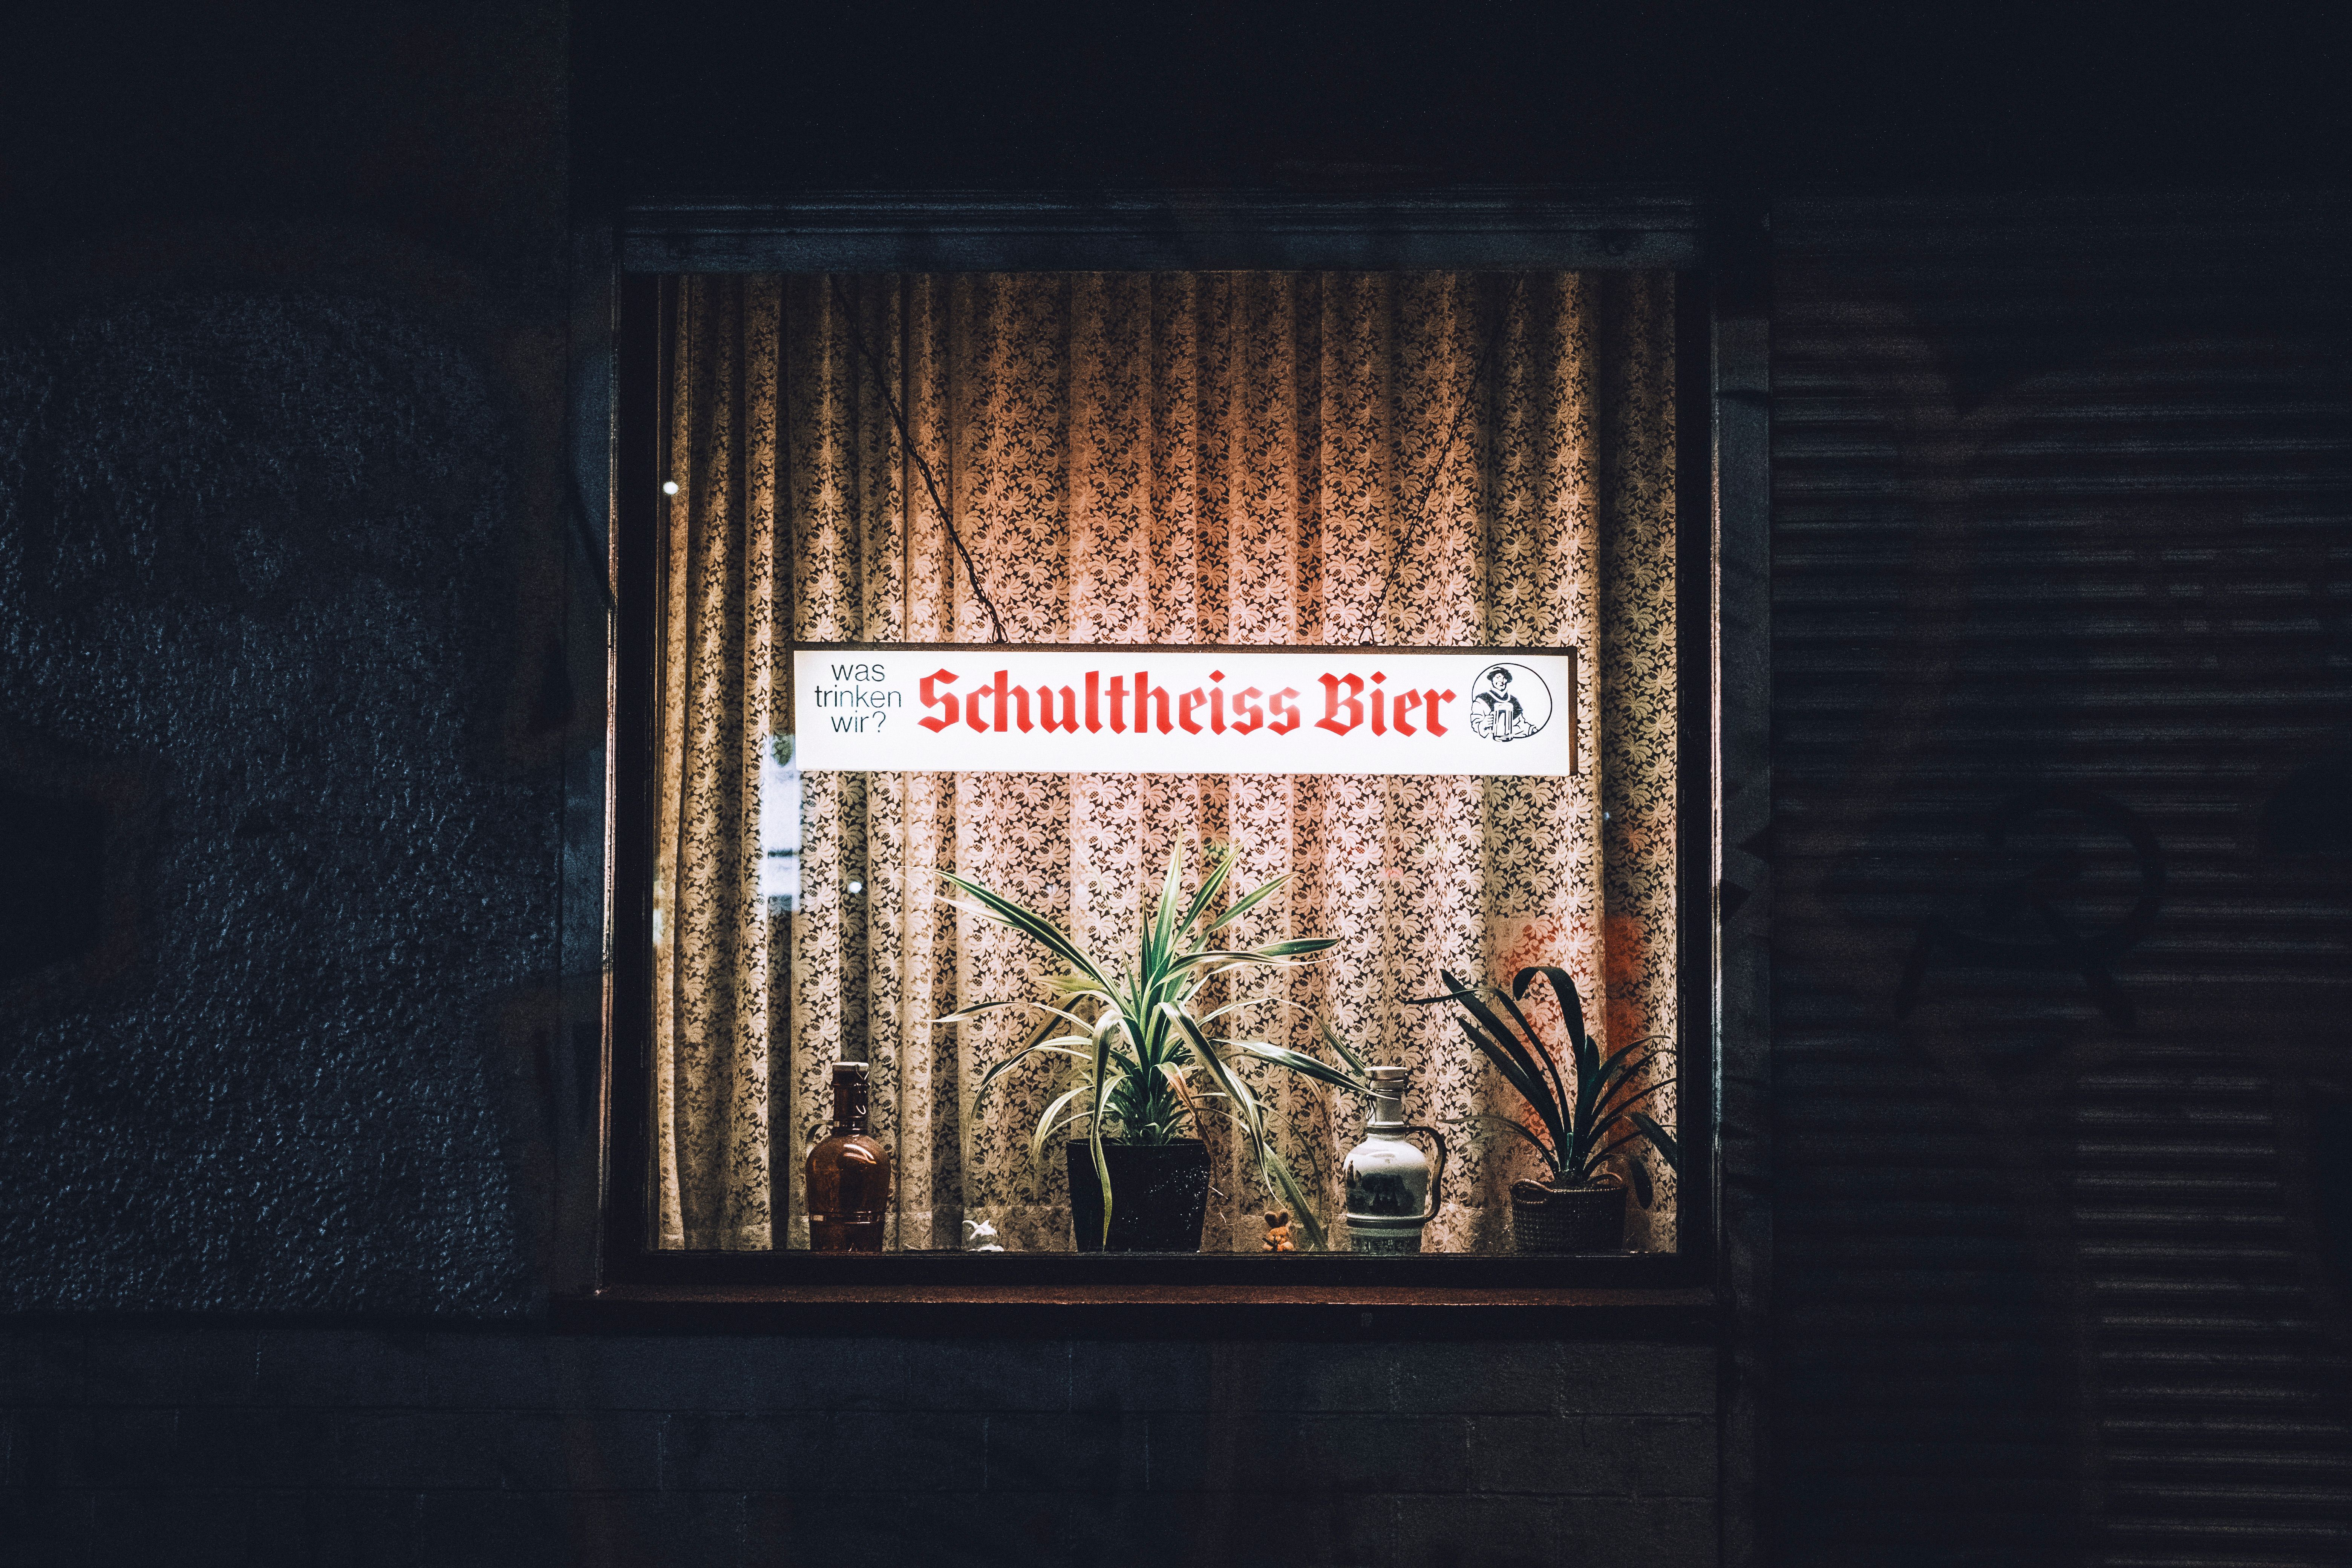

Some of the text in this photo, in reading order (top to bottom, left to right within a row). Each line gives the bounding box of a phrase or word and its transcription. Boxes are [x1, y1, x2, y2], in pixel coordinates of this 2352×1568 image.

[831, 664, 885, 682] was
[814, 684, 902, 708] trinken
[918, 668, 1457, 737] Schultheiss Bier
[831, 711, 887, 733] wir?
